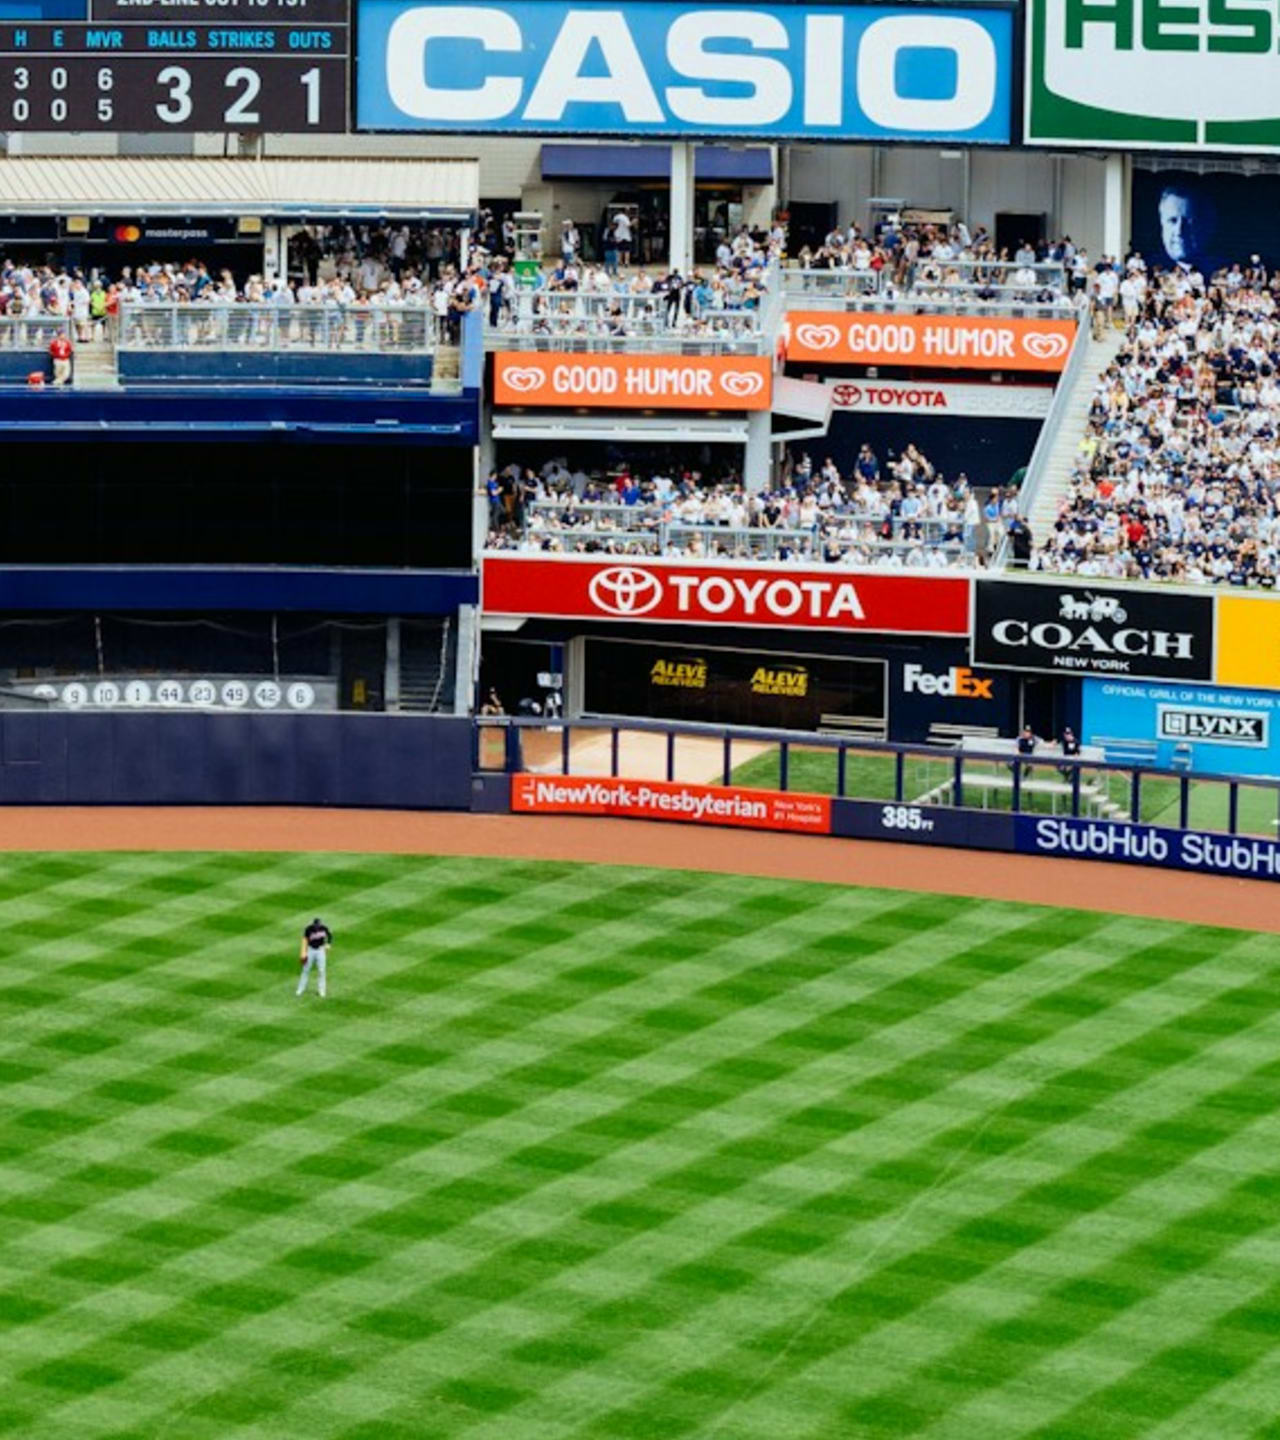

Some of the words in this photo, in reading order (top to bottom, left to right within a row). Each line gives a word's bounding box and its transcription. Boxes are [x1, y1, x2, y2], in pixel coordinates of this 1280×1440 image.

[148, 32, 196, 47] BALLS
[208, 32, 275, 47] STRIKES
[290, 32, 331, 47] OUTS
[386, 6, 997, 131] CASIO
[156, 66, 192, 123] 3
[224, 66, 261, 123] 2
[300, 68, 320, 124] 1
[848, 323, 915, 353] GOOD
[922, 326, 1015, 358] HUMOR
[552, 366, 618, 394] GOOD
[624, 367, 714, 397] HUMOR
[866, 388, 947, 407] TOYOTA
[668, 575, 866, 621] TOYOTA
[992, 620, 1193, 659] COACH
[1053, 655, 1088, 669] NEW
[1091, 659, 1130, 671] YORK
[903, 664, 993, 699] FedEx
[1190, 715, 1257, 736] LYNX
[536, 782, 766, 819] NewYork-Presbyterian
[1036, 819, 1168, 860] StubHub
